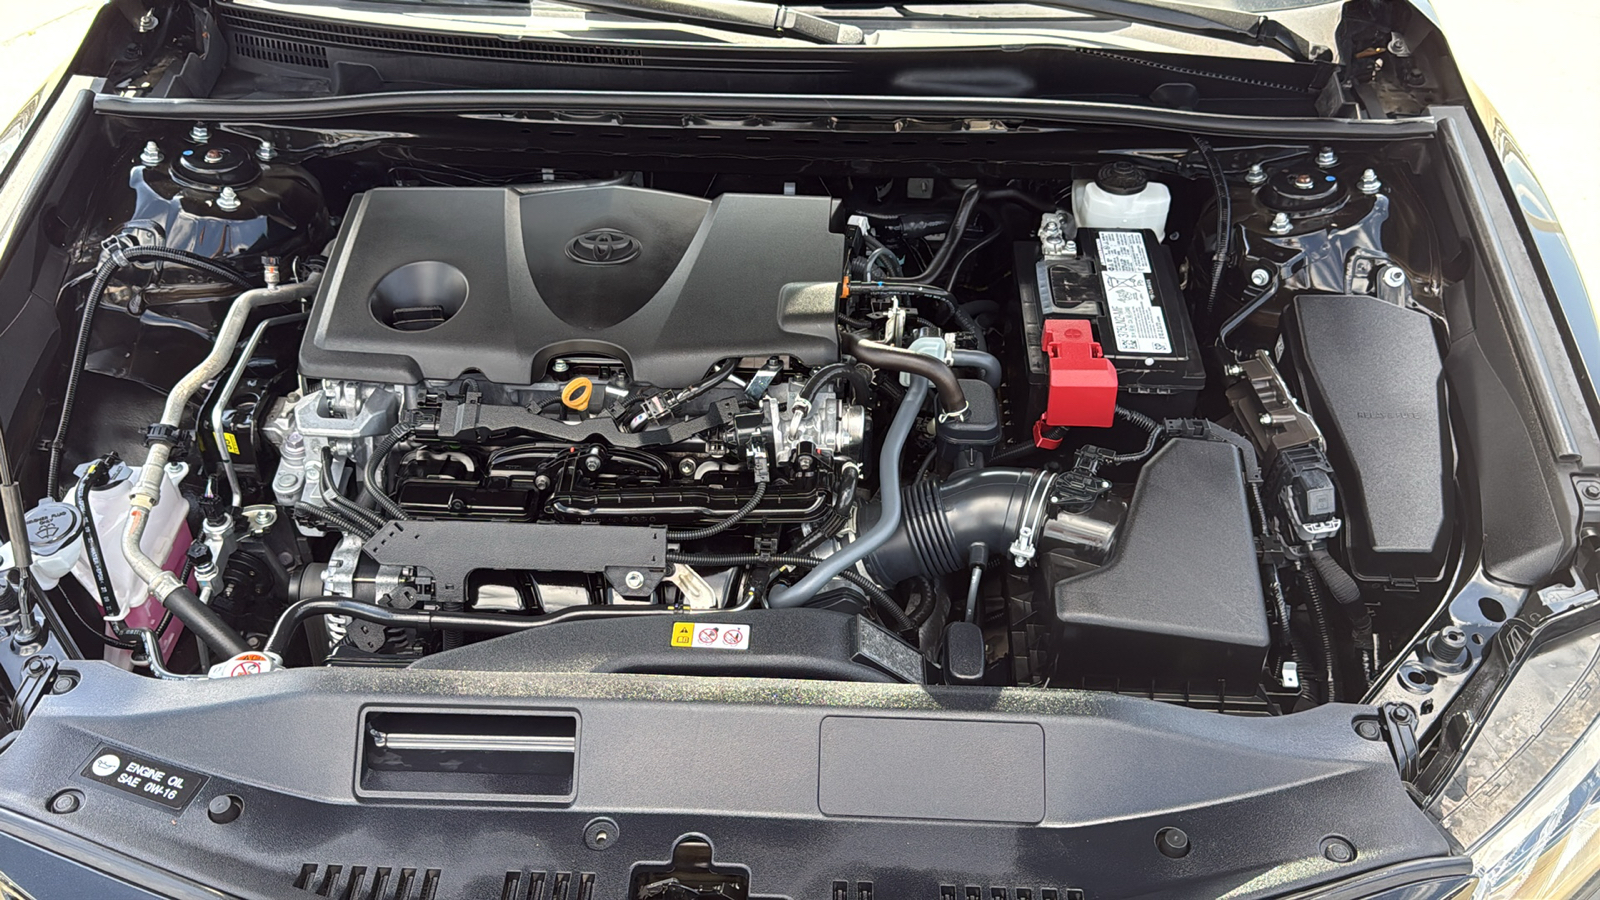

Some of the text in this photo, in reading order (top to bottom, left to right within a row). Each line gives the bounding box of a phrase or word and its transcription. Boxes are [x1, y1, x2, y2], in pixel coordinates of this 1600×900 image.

[117, 773, 178, 800] SAE 0W-16
[125, 761, 184, 789] ENGINE OIL
